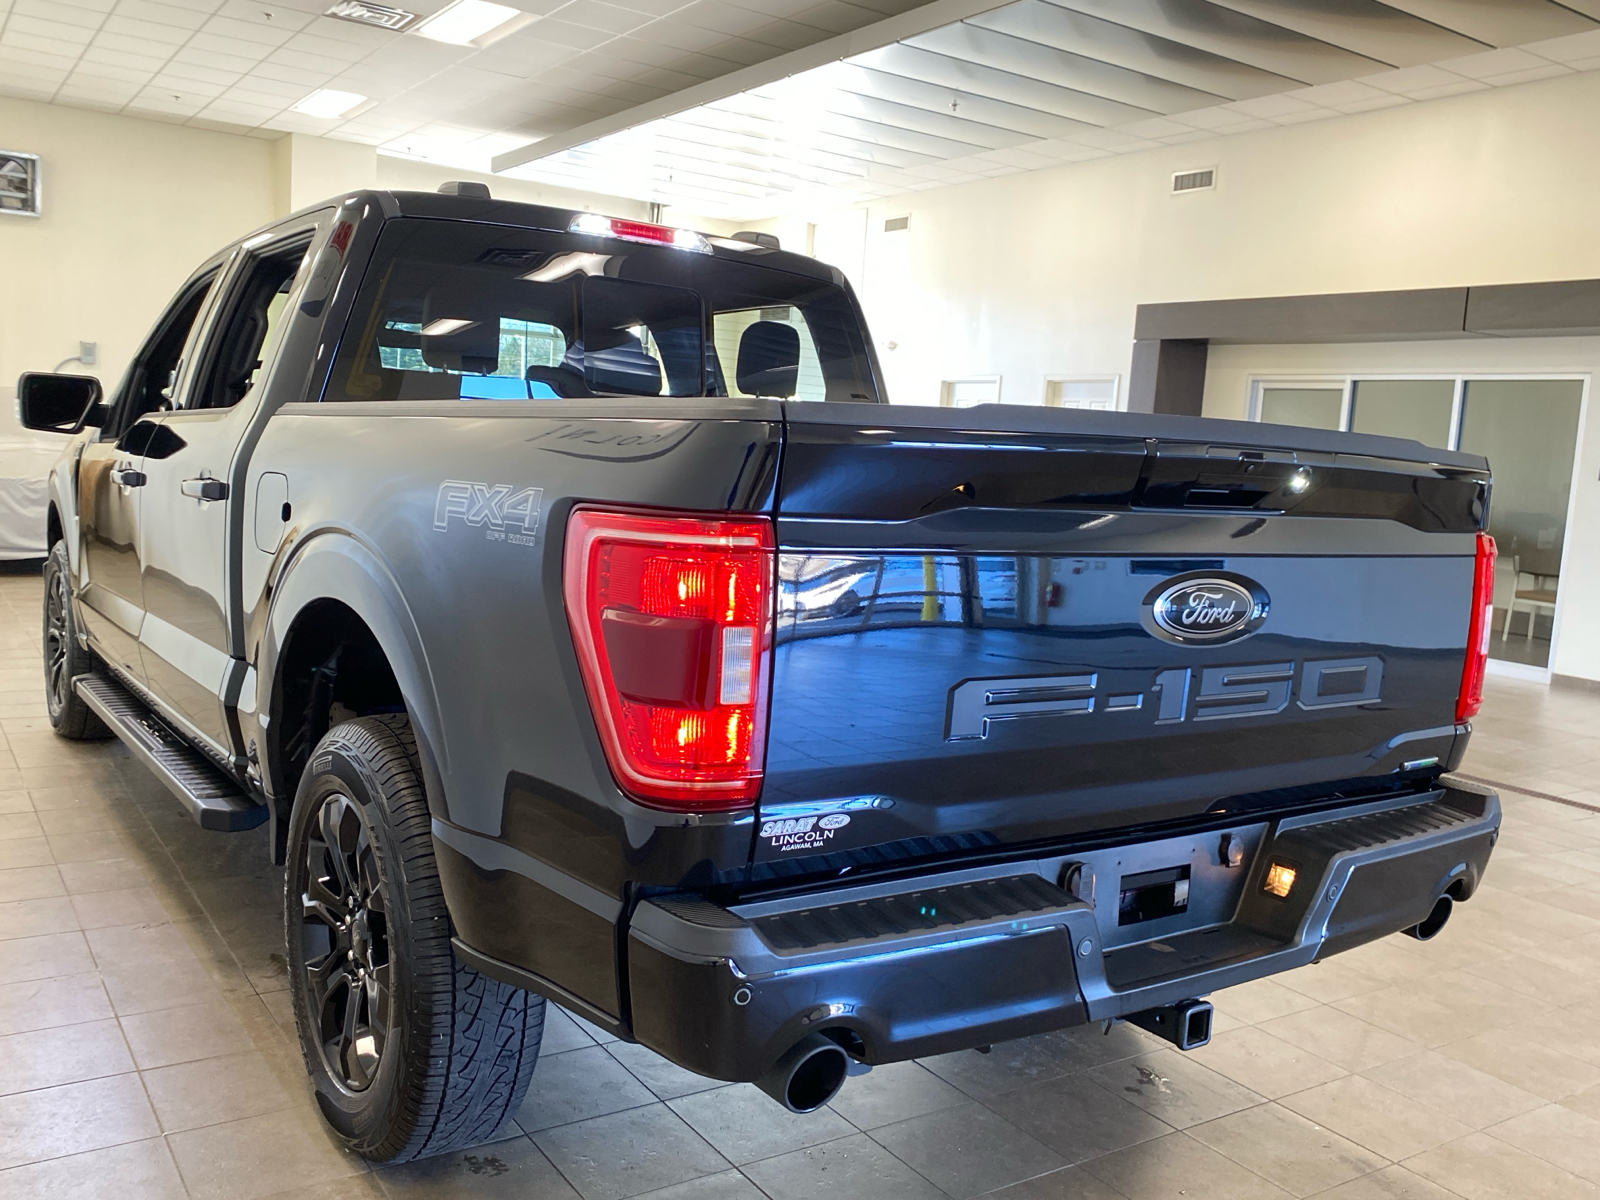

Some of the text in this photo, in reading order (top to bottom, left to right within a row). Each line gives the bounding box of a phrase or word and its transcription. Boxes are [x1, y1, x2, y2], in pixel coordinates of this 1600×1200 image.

[433, 479, 544, 535] FX4
[486, 531, 536, 546] OFF ROAD
[1181, 591, 1236, 625] Ford
[943, 653, 1386, 743] F-150
[760, 815, 846, 838] SARAT Ford
[771, 829, 835, 846] LINCOLN
[781, 842, 812, 851] AGAWAM,
